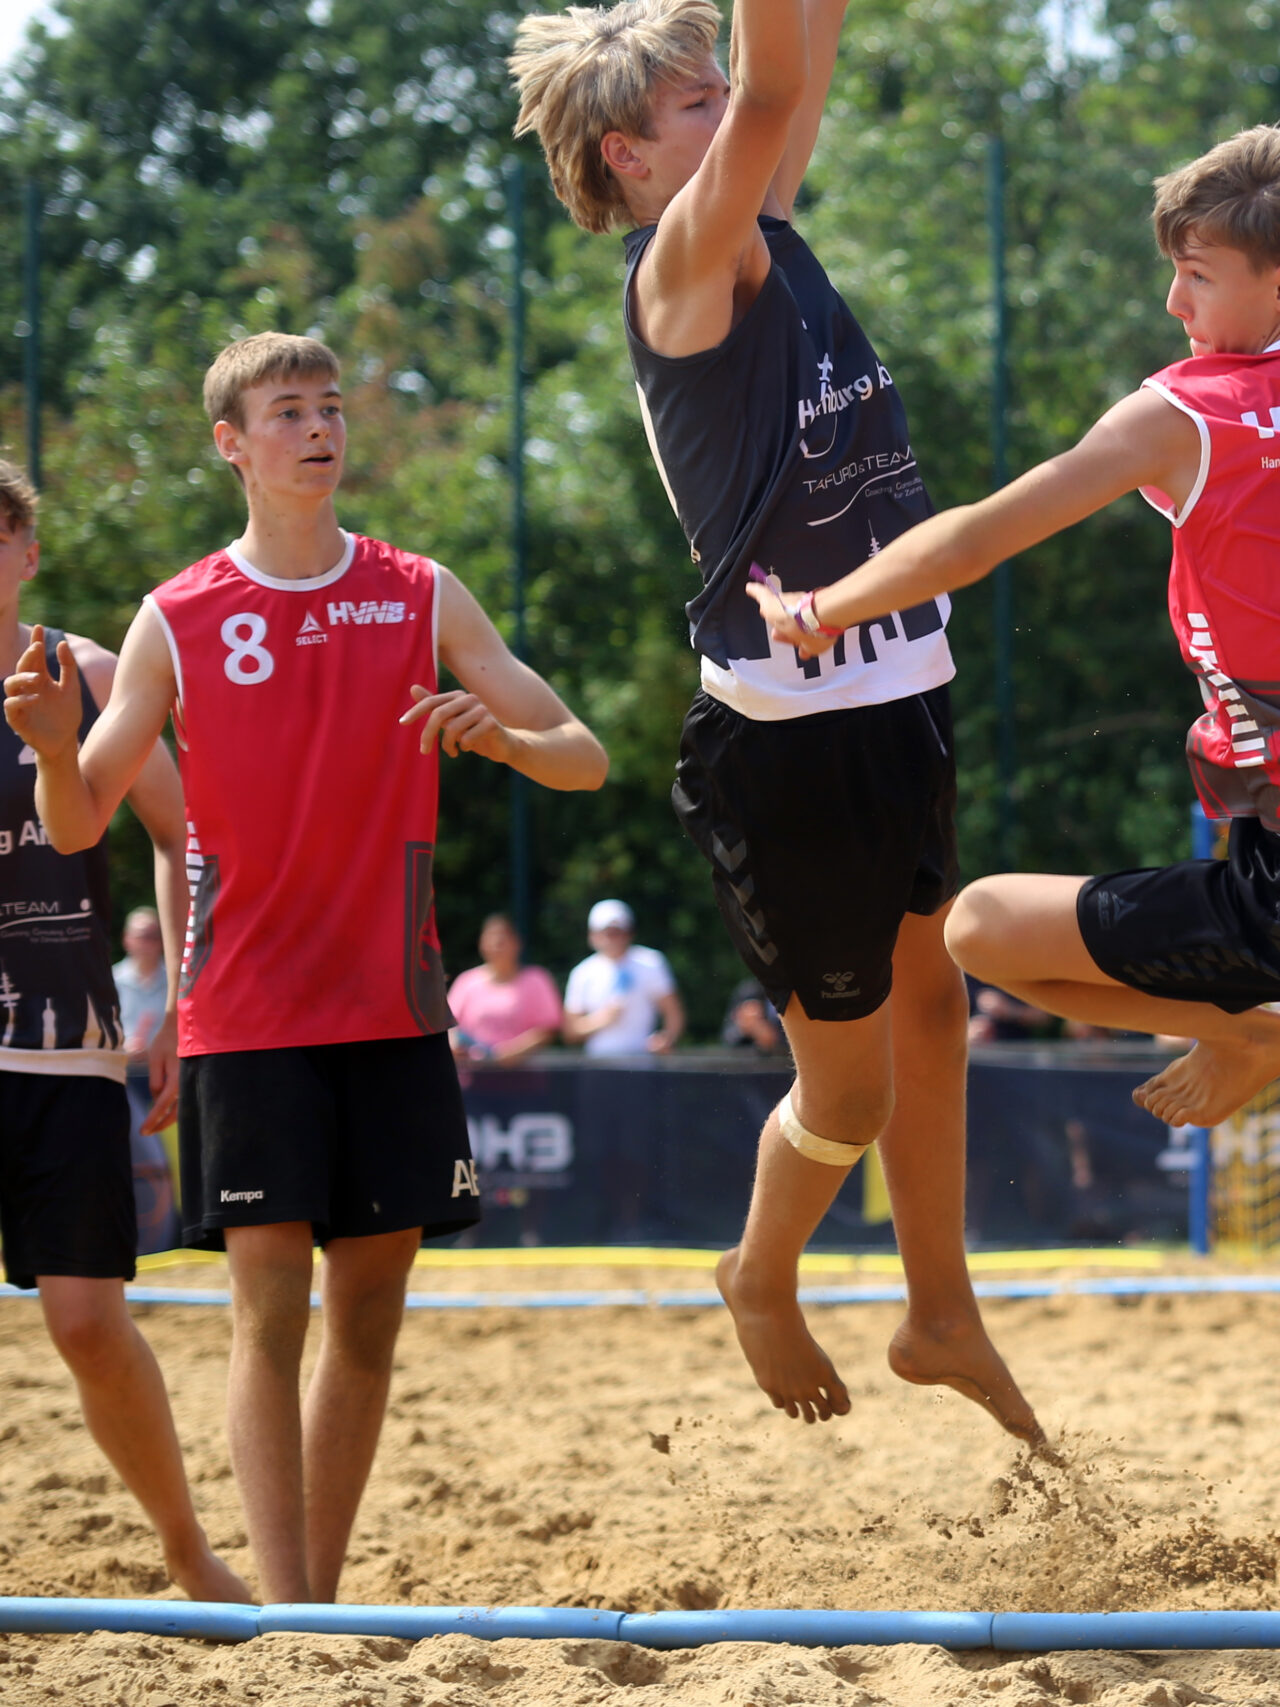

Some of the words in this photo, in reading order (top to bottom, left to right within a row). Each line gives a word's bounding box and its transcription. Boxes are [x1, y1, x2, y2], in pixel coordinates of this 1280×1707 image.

[296, 633, 328, 646] SELECT
[220, 612, 275, 685] 8
[220, 1190, 264, 1203] Kempa
